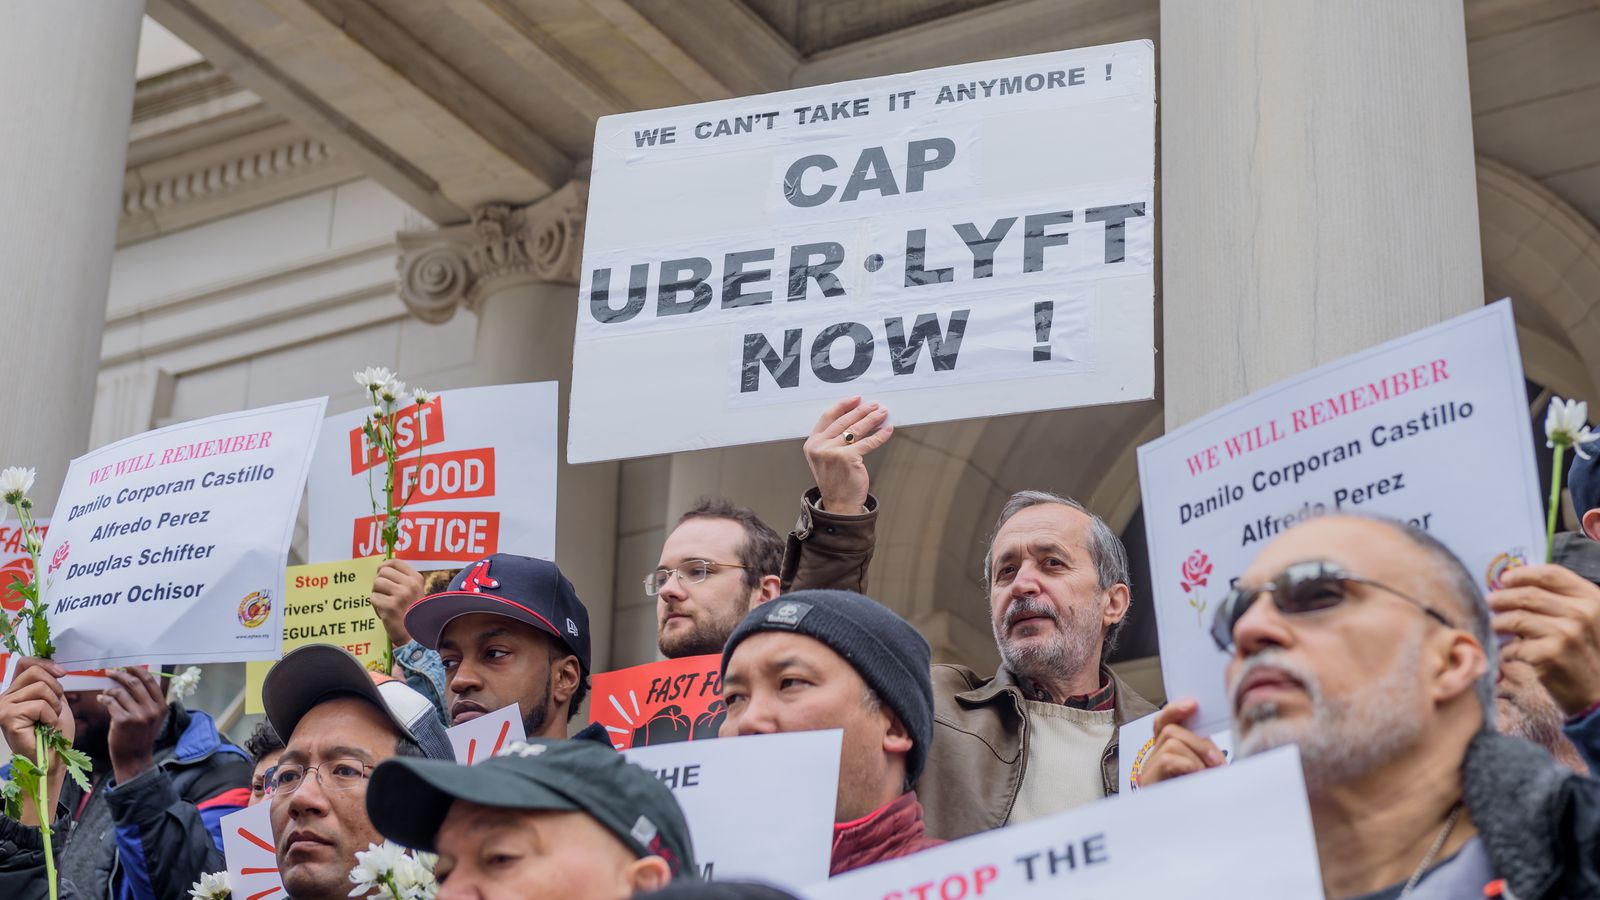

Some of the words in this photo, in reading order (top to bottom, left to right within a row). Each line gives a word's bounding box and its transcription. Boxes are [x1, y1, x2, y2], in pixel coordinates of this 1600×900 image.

[634, 125, 676, 148] WE
[694, 111, 780, 140] CAN'T
[794, 98, 870, 125] TAKE
[888, 90, 916, 111] IT
[935, 67, 1086, 105] ANYMORE
[1104, 63, 1113, 82] !
[783, 137, 956, 208] CAP
[589, 240, 847, 324] UBER
[904, 201, 1147, 288] LYFT
[740, 308, 971, 393] NOW
[1032, 300, 1055, 363] !
[1186, 445, 1220, 477] WE
[1224, 421, 1286, 459] WILL
[1290, 358, 1450, 435] REMEMBER
[88, 464, 113, 486] WE
[114, 452, 156, 477] WILL
[160, 431, 273, 465] REMEMBER
[402, 458, 484, 500] FOOD
[1179, 483, 1244, 526] Danilo
[1251, 440, 1362, 493] Corporan
[1370, 399, 1475, 448] Castillo
[68, 495, 113, 521] Danilo
[116, 477, 195, 508] Corporan
[201, 464, 275, 489] Castillo
[1334, 471, 1405, 508] Perez
[90, 516, 152, 542] Alfredo
[156, 508, 211, 529] Perez
[66, 554, 132, 580] Douglas
[138, 543, 215, 567] Schifter
[295, 576, 329, 589] Stop
[333, 571, 356, 584] the
[54, 591, 122, 615] Nicanor
[127, 582, 205, 604] Ochisor
[283, 600, 328, 616] rivers'
[333, 595, 372, 611] Crisis
[283, 622, 346, 641] EGULATE
[351, 618, 376, 632] THE
[646, 672, 700, 705] FAST
[655, 764, 701, 790] HE
[1015, 833, 1109, 882] THE
